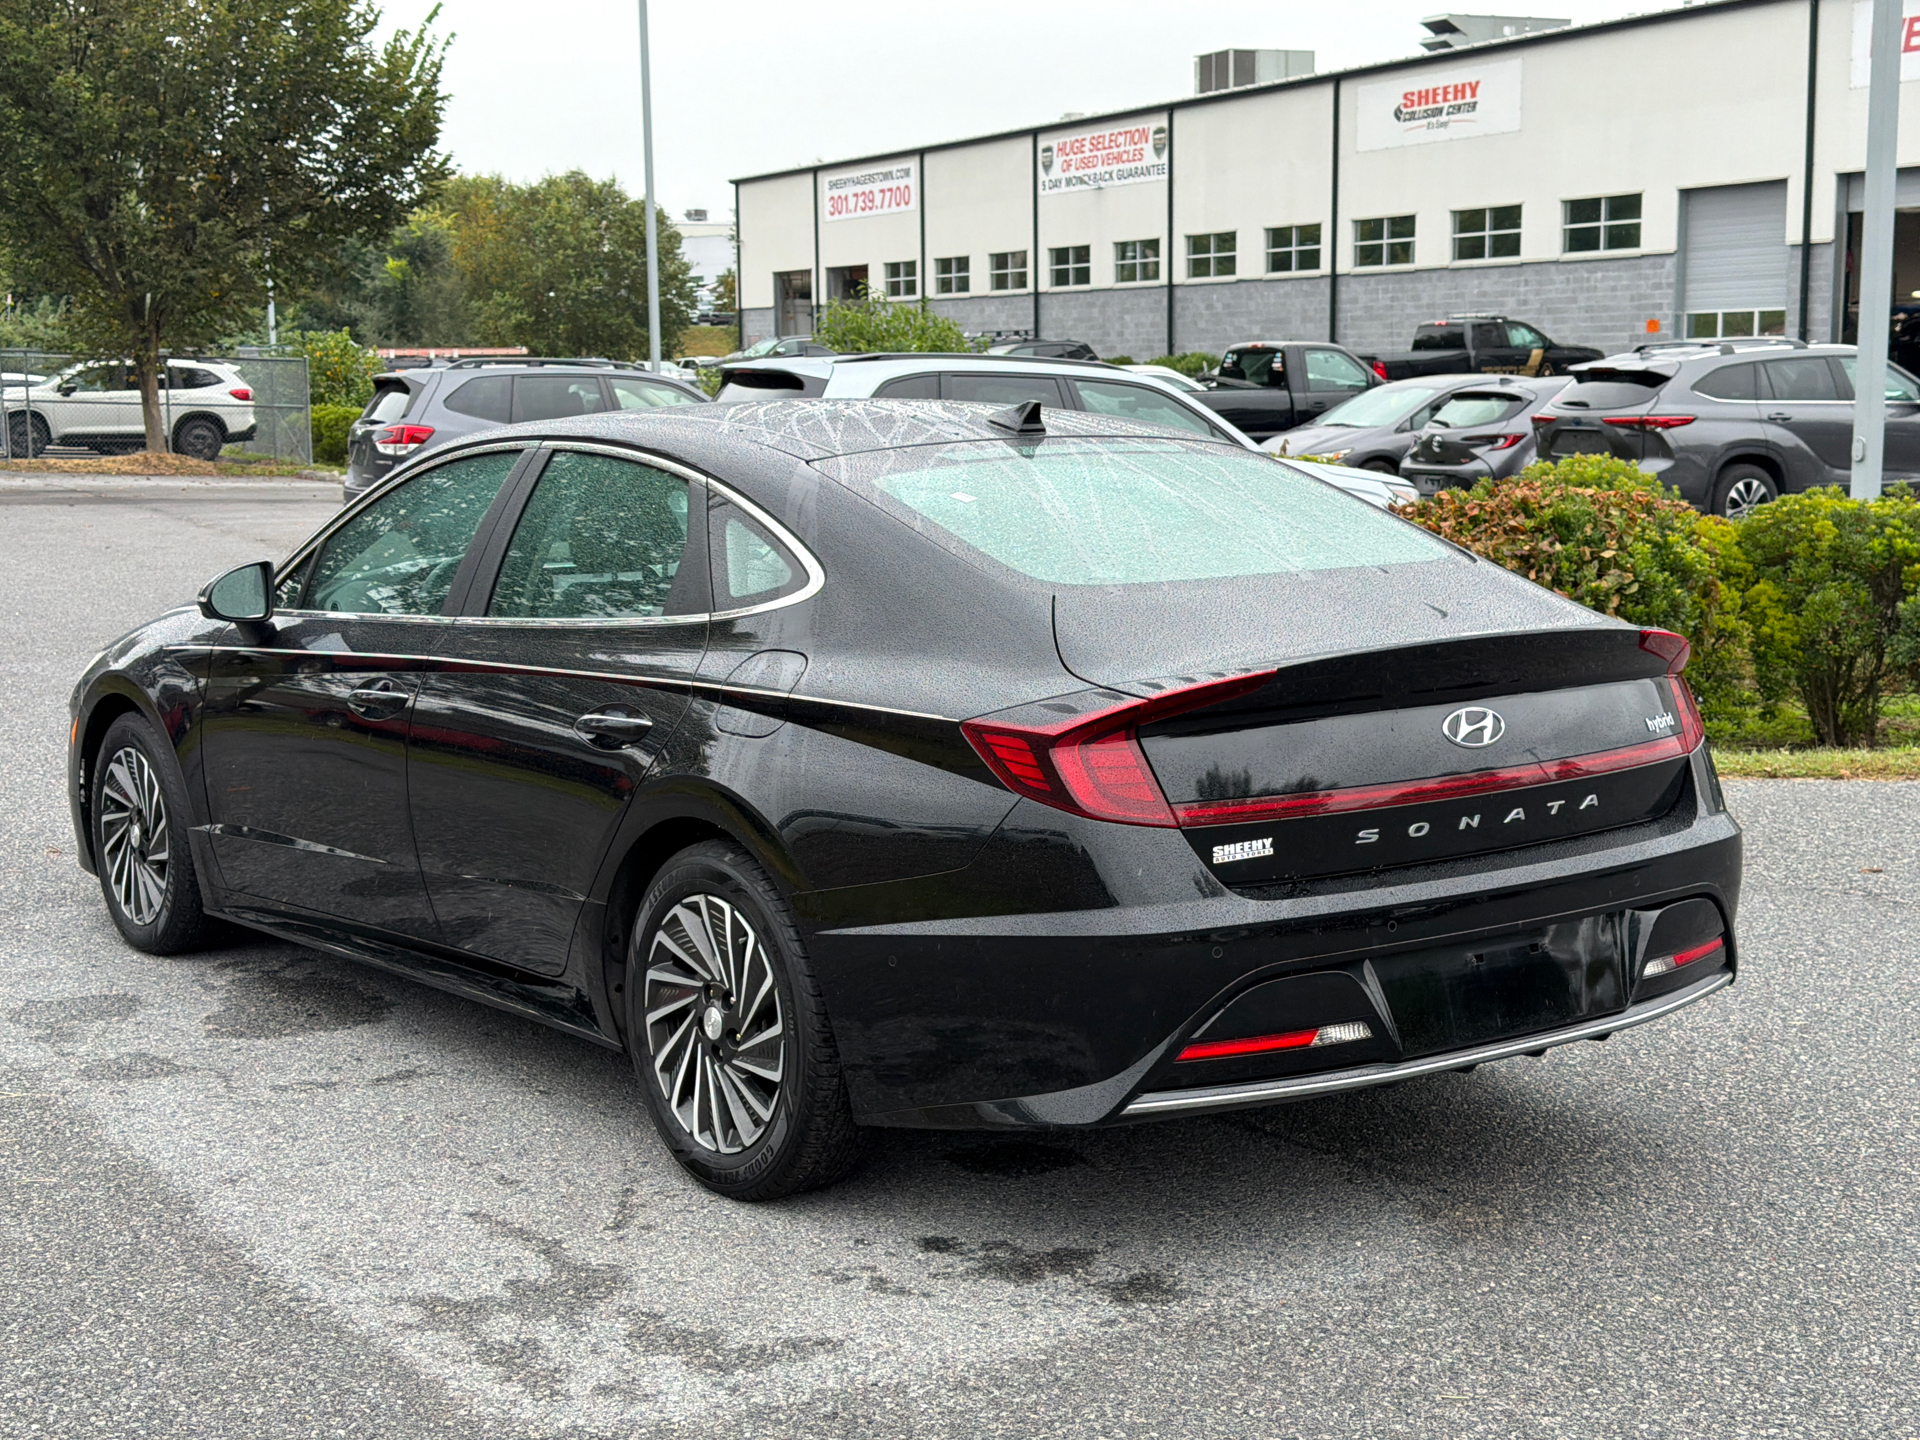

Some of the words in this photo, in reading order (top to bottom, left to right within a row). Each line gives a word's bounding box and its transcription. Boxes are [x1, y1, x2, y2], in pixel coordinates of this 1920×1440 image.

[1402, 79, 1481, 109] SHEEHY
[1402, 105, 1445, 123] COLLISION
[1446, 101, 1478, 116] CENTER
[1056, 137, 1087, 158] HUGE
[1088, 127, 1150, 153] SELECTION
[1061, 157, 1074, 173] OF
[1075, 153, 1099, 171] USED
[1100, 147, 1144, 167] VEHICLES
[828, 167, 911, 191] SHEEHYHAGERSTOWN.COM
[1048, 177, 1063, 190] DAY
[1115, 163, 1166, 180] GUARANTEE
[828, 184, 911, 217] 301.739.7700
[1645, 711, 1675, 734] hybrid
[1354, 793, 1600, 845] SONATA
[1212, 837, 1273, 857] SHEEHY
[1214, 855, 1237, 863] AUTO
[1240, 848, 1272, 859] STORES
